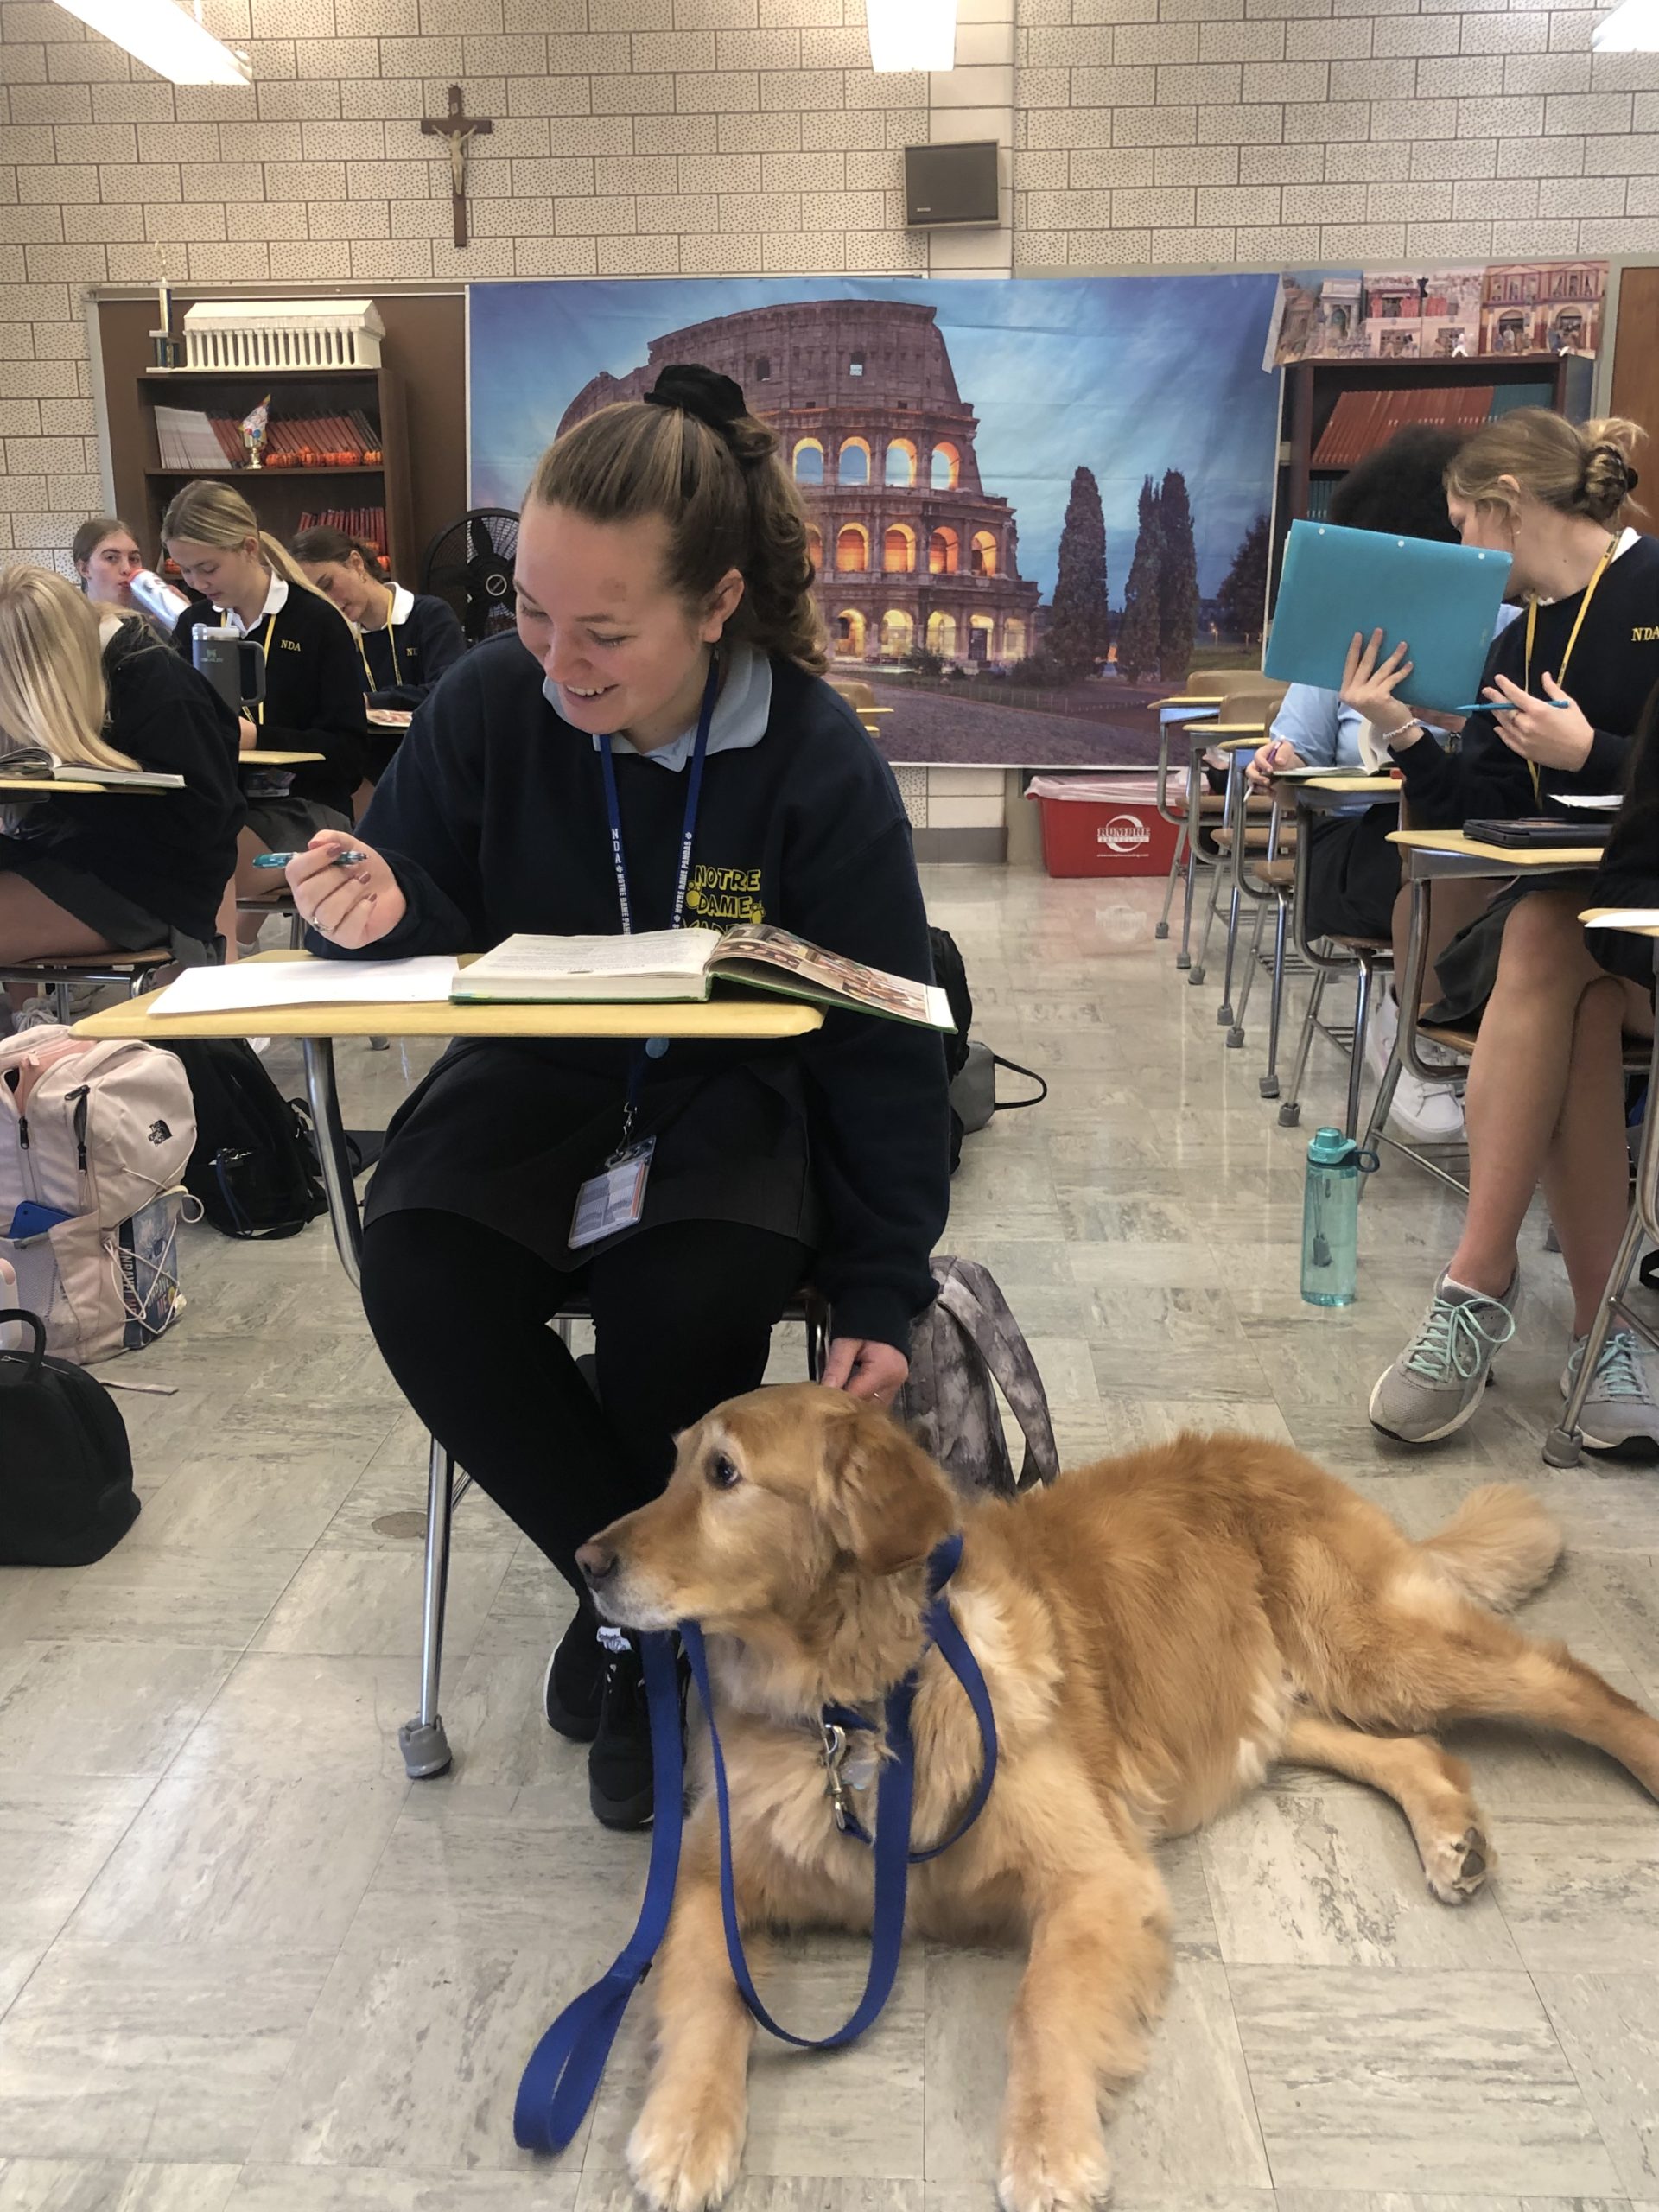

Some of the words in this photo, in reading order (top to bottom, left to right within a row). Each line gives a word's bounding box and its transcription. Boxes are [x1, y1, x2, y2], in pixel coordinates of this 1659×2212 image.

[280, 639, 301, 652] NDA
[611, 829, 621, 863] NDA
[682, 841, 691, 869] PANDAS
[617, 874, 626, 896] NOTRE
[678, 870, 688, 891] DAME
[695, 865, 761, 892] NOTRE
[620, 897, 629, 917] DAME
[675, 891, 685, 914] NOTRE
[696, 895, 753, 918] DAME
